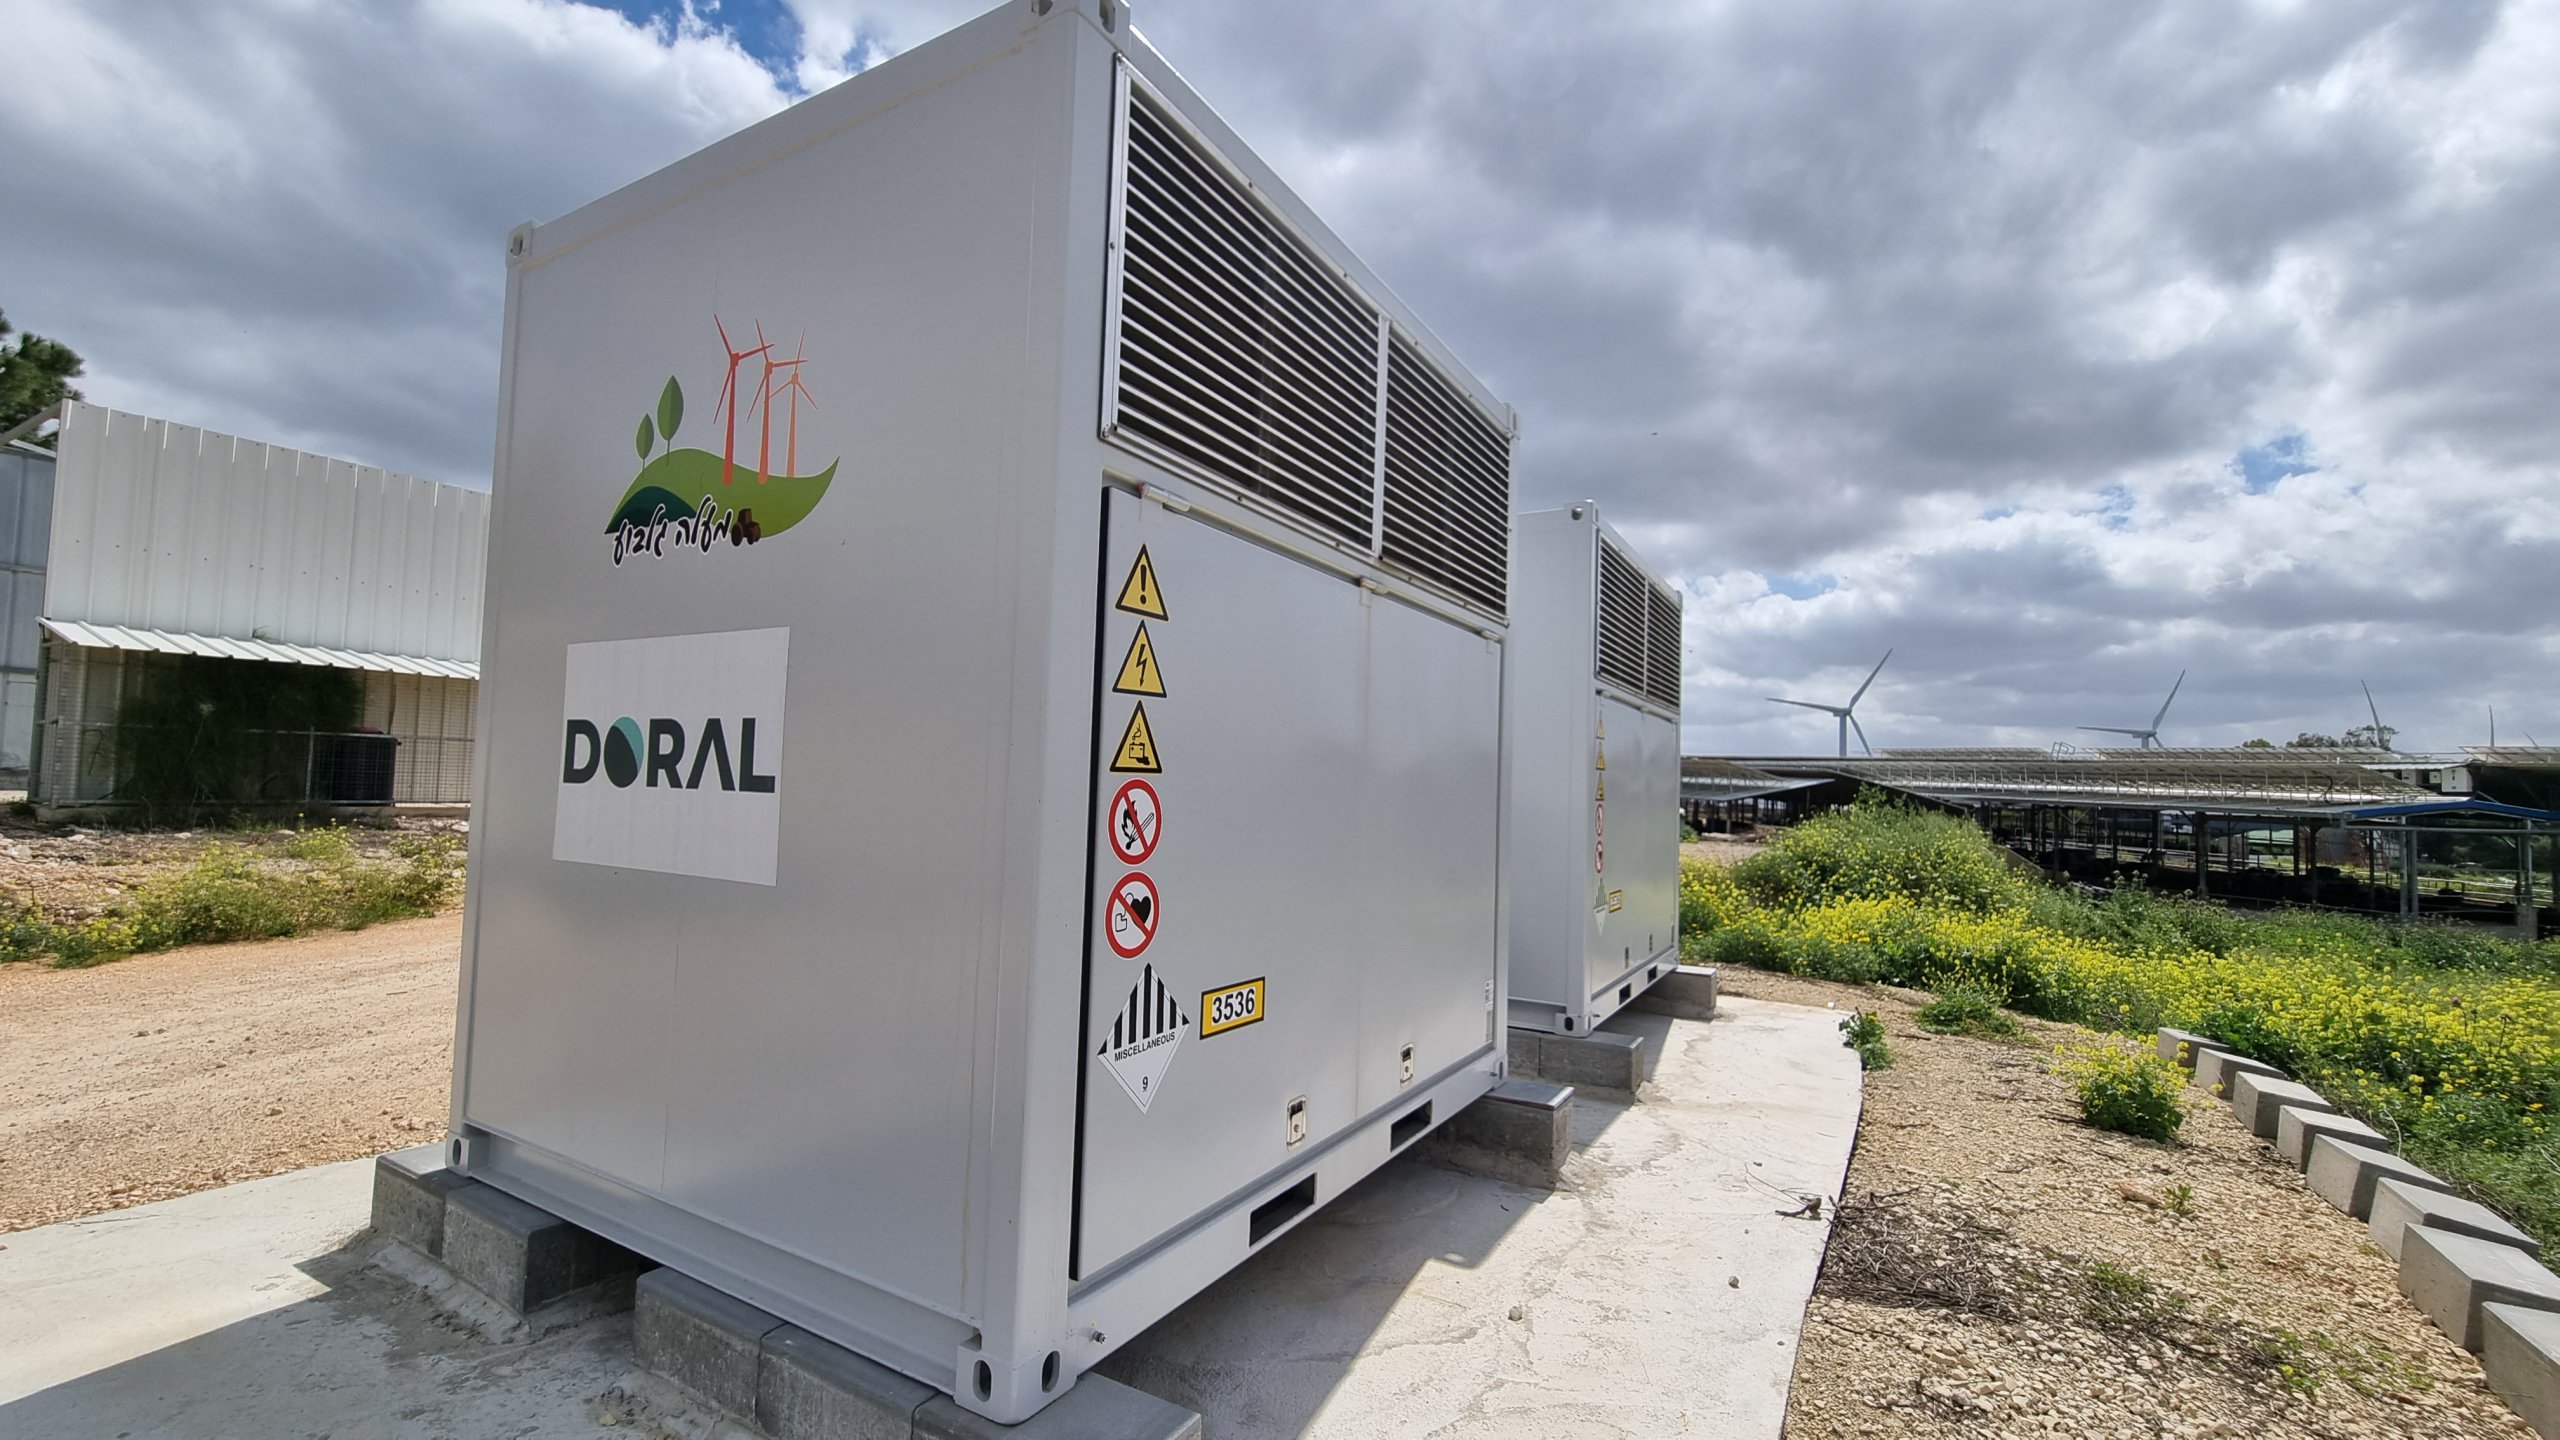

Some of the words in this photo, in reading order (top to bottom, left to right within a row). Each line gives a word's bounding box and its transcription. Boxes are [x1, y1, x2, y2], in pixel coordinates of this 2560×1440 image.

[613, 505, 668, 566] גלבוע
[675, 496, 732, 553] מעלה
[563, 716, 776, 793] DORAL
[1212, 988, 1255, 1024] 3536
[1114, 1032, 1175, 1062] MISCELLANEOUS
[1142, 1076, 1149, 1090] 9
